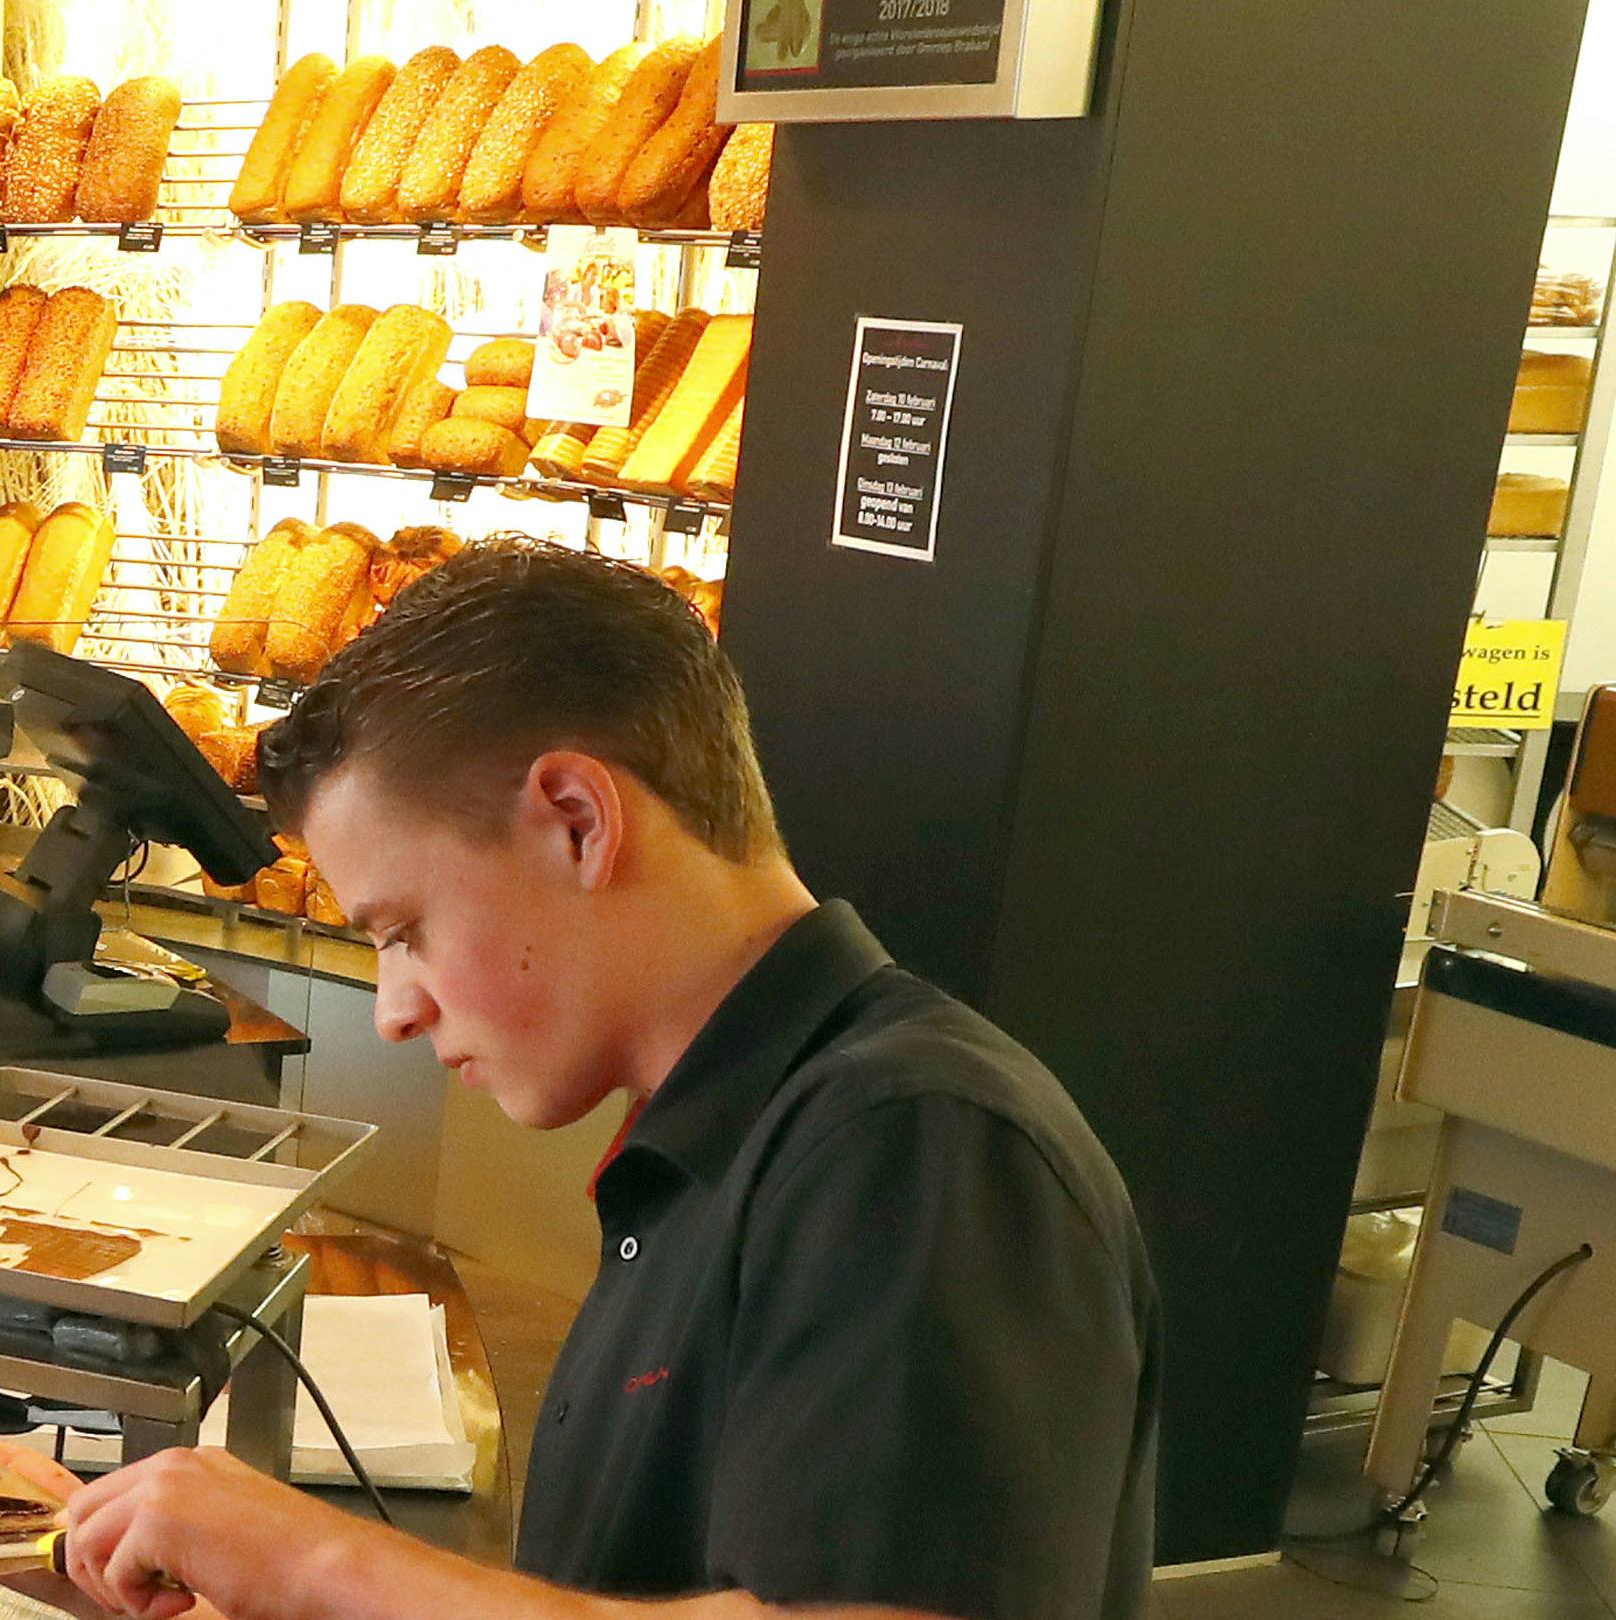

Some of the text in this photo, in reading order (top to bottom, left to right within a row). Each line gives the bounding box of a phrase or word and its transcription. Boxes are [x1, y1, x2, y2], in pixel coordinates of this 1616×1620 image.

[879, 0, 950, 21] 2017/2018
[860, 496, 914, 514] geopend van
[1533, 645, 1550, 660] is
